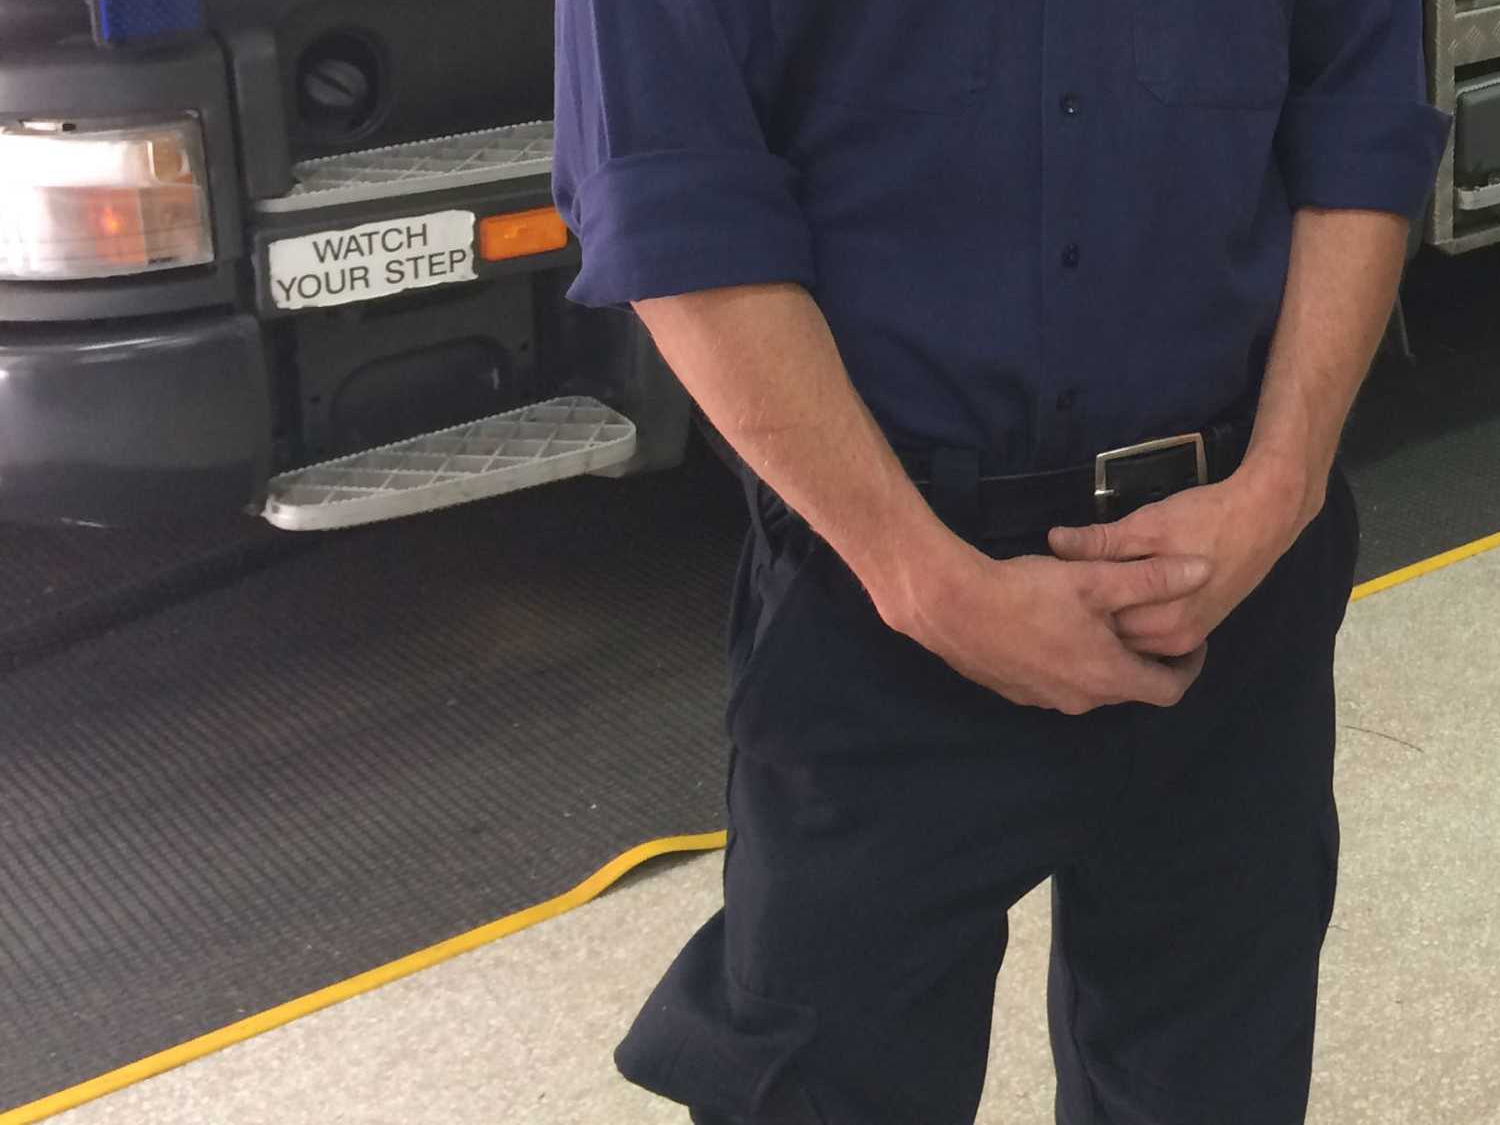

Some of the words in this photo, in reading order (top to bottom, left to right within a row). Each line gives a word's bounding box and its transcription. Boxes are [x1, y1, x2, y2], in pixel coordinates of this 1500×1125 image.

[312, 223, 428, 264] WATCH
[276, 266, 370, 302] YOUR
[385, 249, 467, 285] STEP
